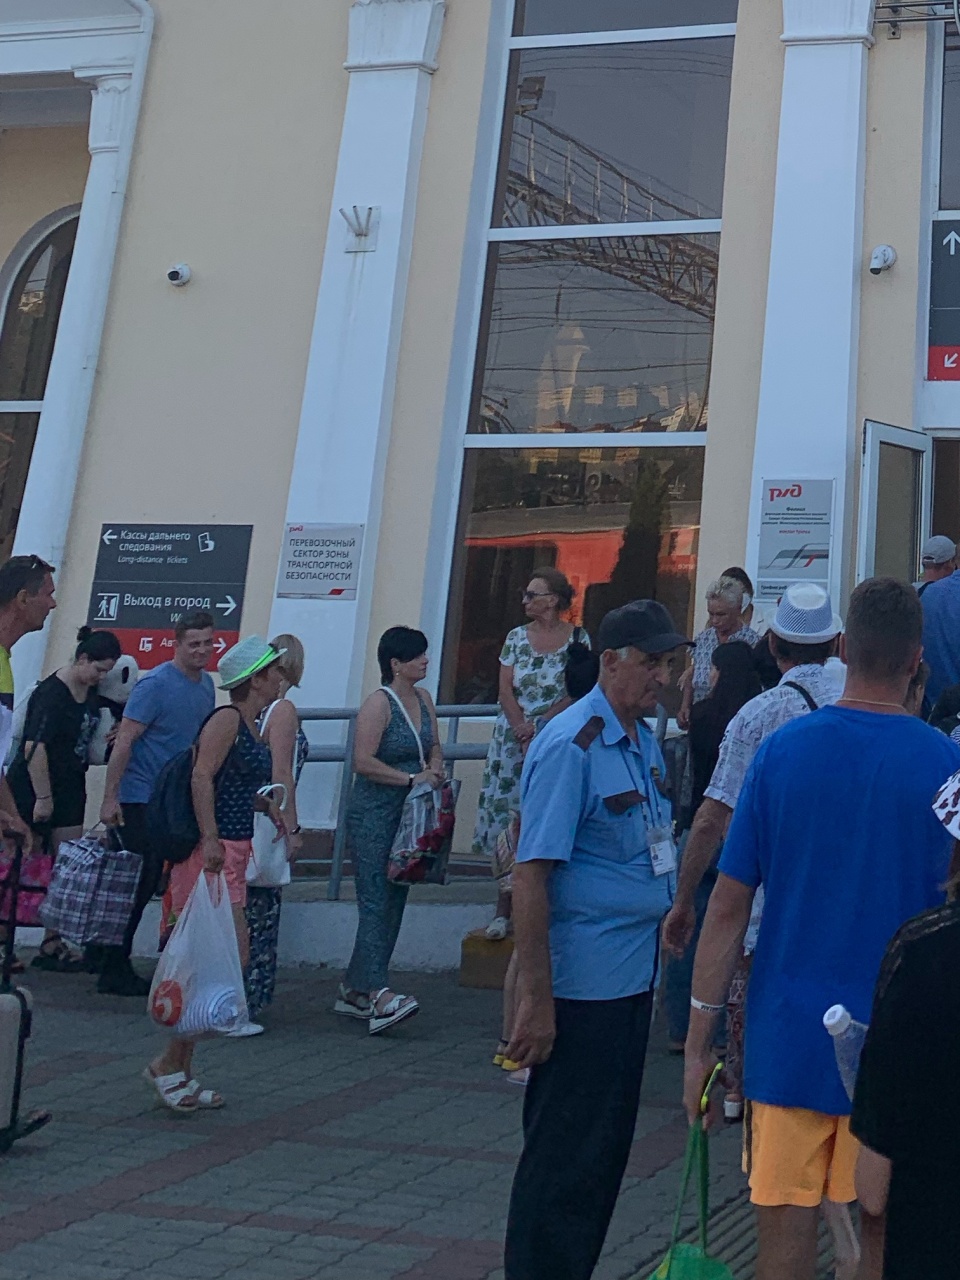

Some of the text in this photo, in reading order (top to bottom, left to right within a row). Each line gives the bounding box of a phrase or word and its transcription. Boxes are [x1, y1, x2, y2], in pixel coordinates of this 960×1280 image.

[120, 530, 191, 541] Кассы дальнего
[119, 542, 173, 552] следования
[289, 538, 356, 547] ПЕРЕВОЗОЧНЫЙ
[293, 549, 349, 558] СЕКТОР ЗОНЫ
[118, 555, 188, 565] Long-distance tickets
[287, 560, 353, 570] ТРАНСПОРТНОЙ
[285, 571, 352, 580] БЕЗОПАСНОСТИ
[123, 593, 211, 611] Выход в город
